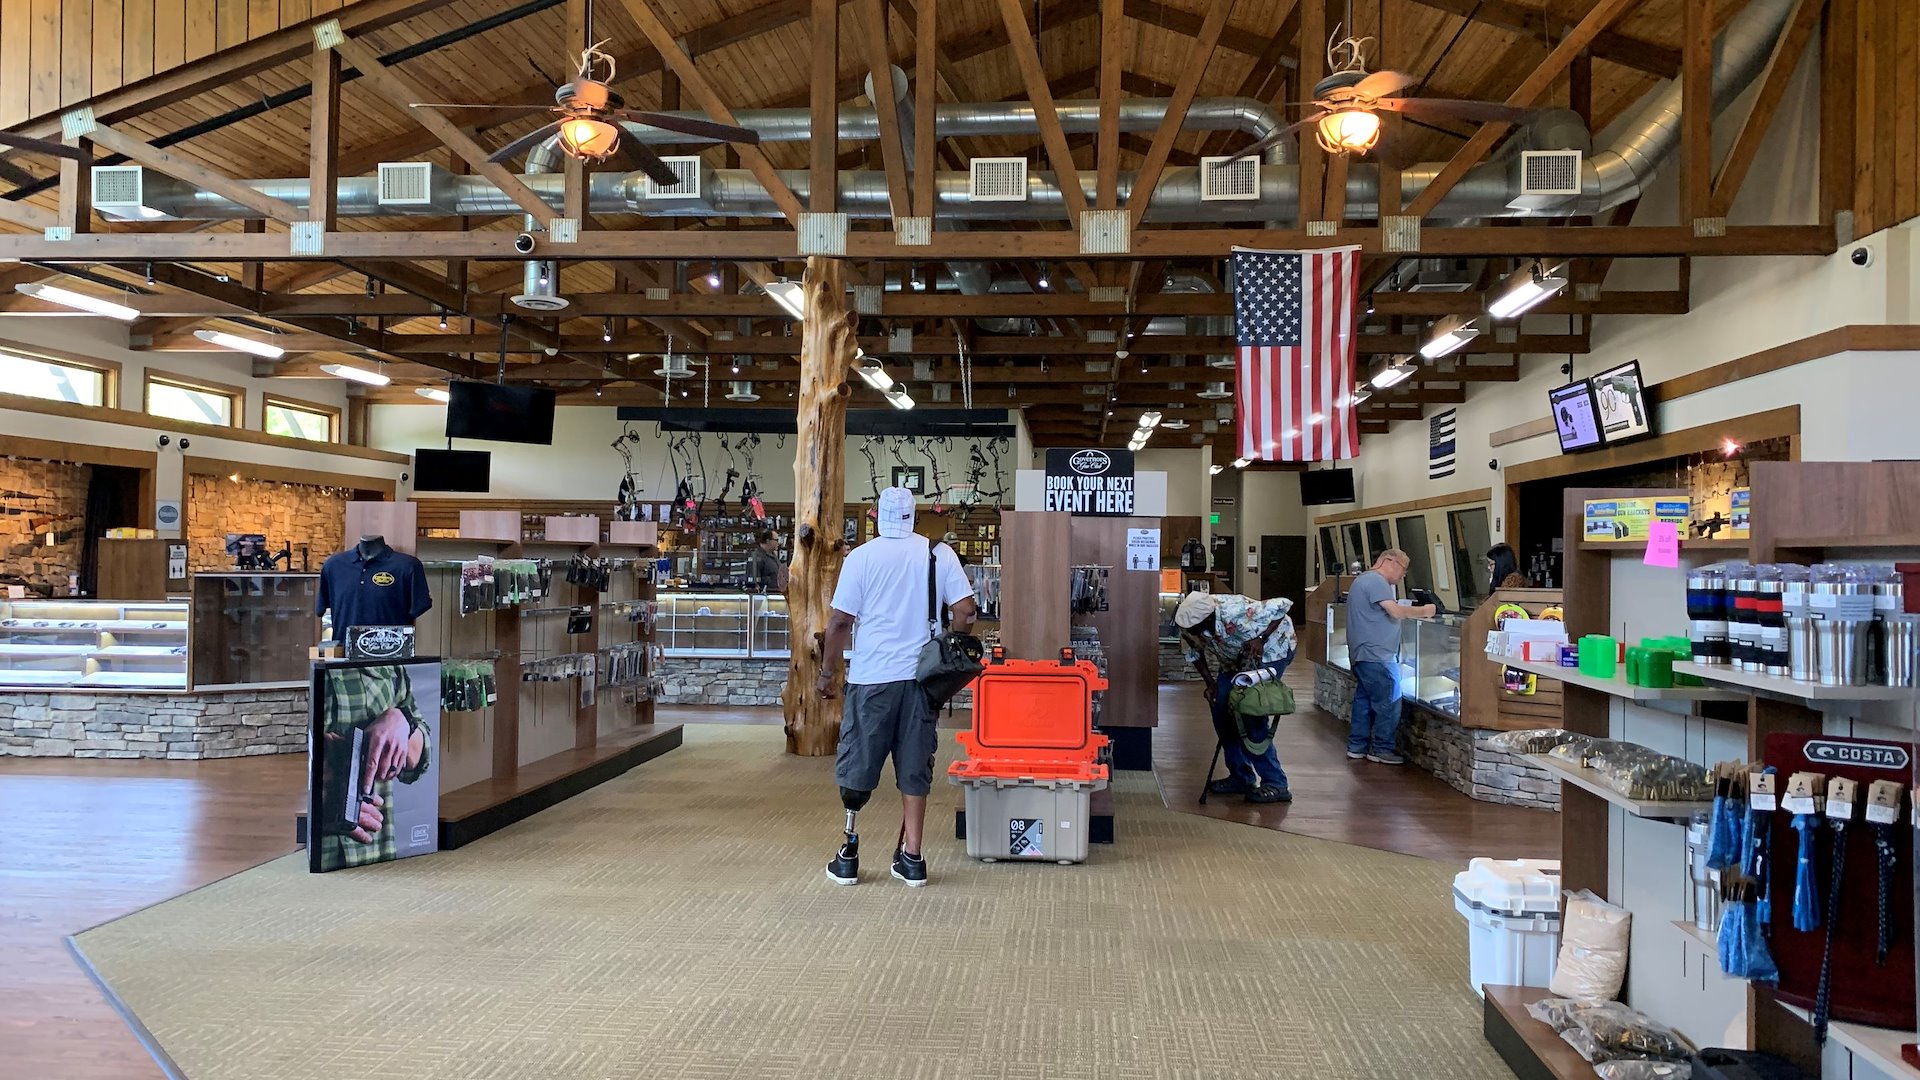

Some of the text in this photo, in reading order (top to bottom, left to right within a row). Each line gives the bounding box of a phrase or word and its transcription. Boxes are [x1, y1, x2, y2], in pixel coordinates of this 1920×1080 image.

[1046, 476, 1133, 491] BOOK YOUR NEXT
[1046, 490, 1133, 513] EVENT HERE
[1838, 748, 1895, 763] COSTA
[1010, 820, 1025, 831] 08
